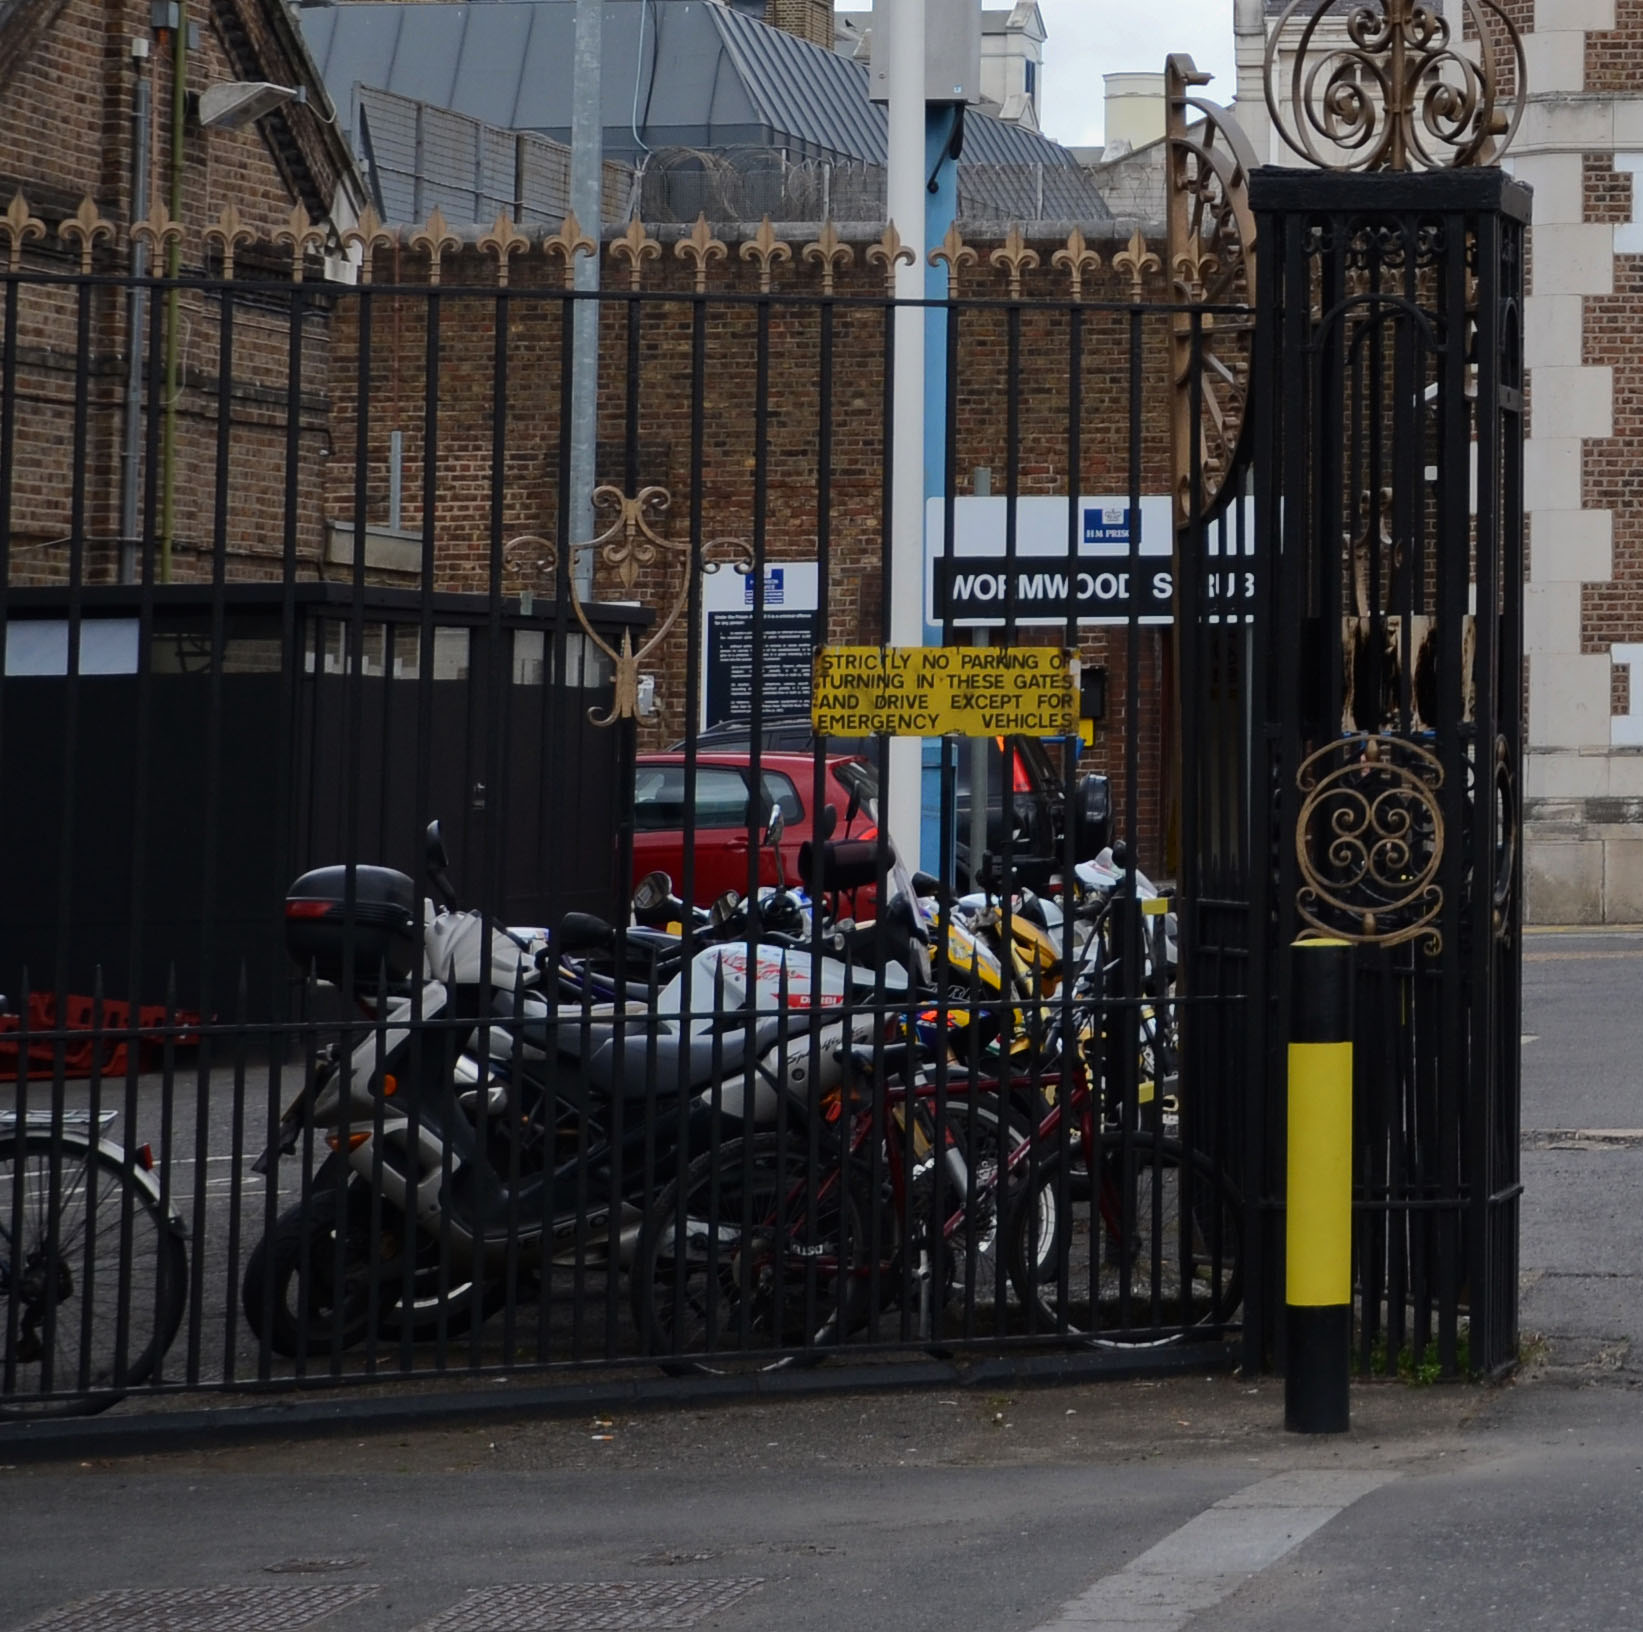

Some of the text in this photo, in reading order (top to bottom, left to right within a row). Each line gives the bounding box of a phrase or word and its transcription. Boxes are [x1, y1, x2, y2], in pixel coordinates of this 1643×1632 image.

[821, 654, 913, 670] STRICTLY
[922, 654, 950, 669] NO
[961, 654, 1039, 670] PARKING
[820, 674, 1073, 690] TURNING IN THESE GATES
[818, 693, 1073, 710] AND DRIVE EXCEPT FOR
[818, 713, 1073, 730] EMERGENCY VEHICLES
